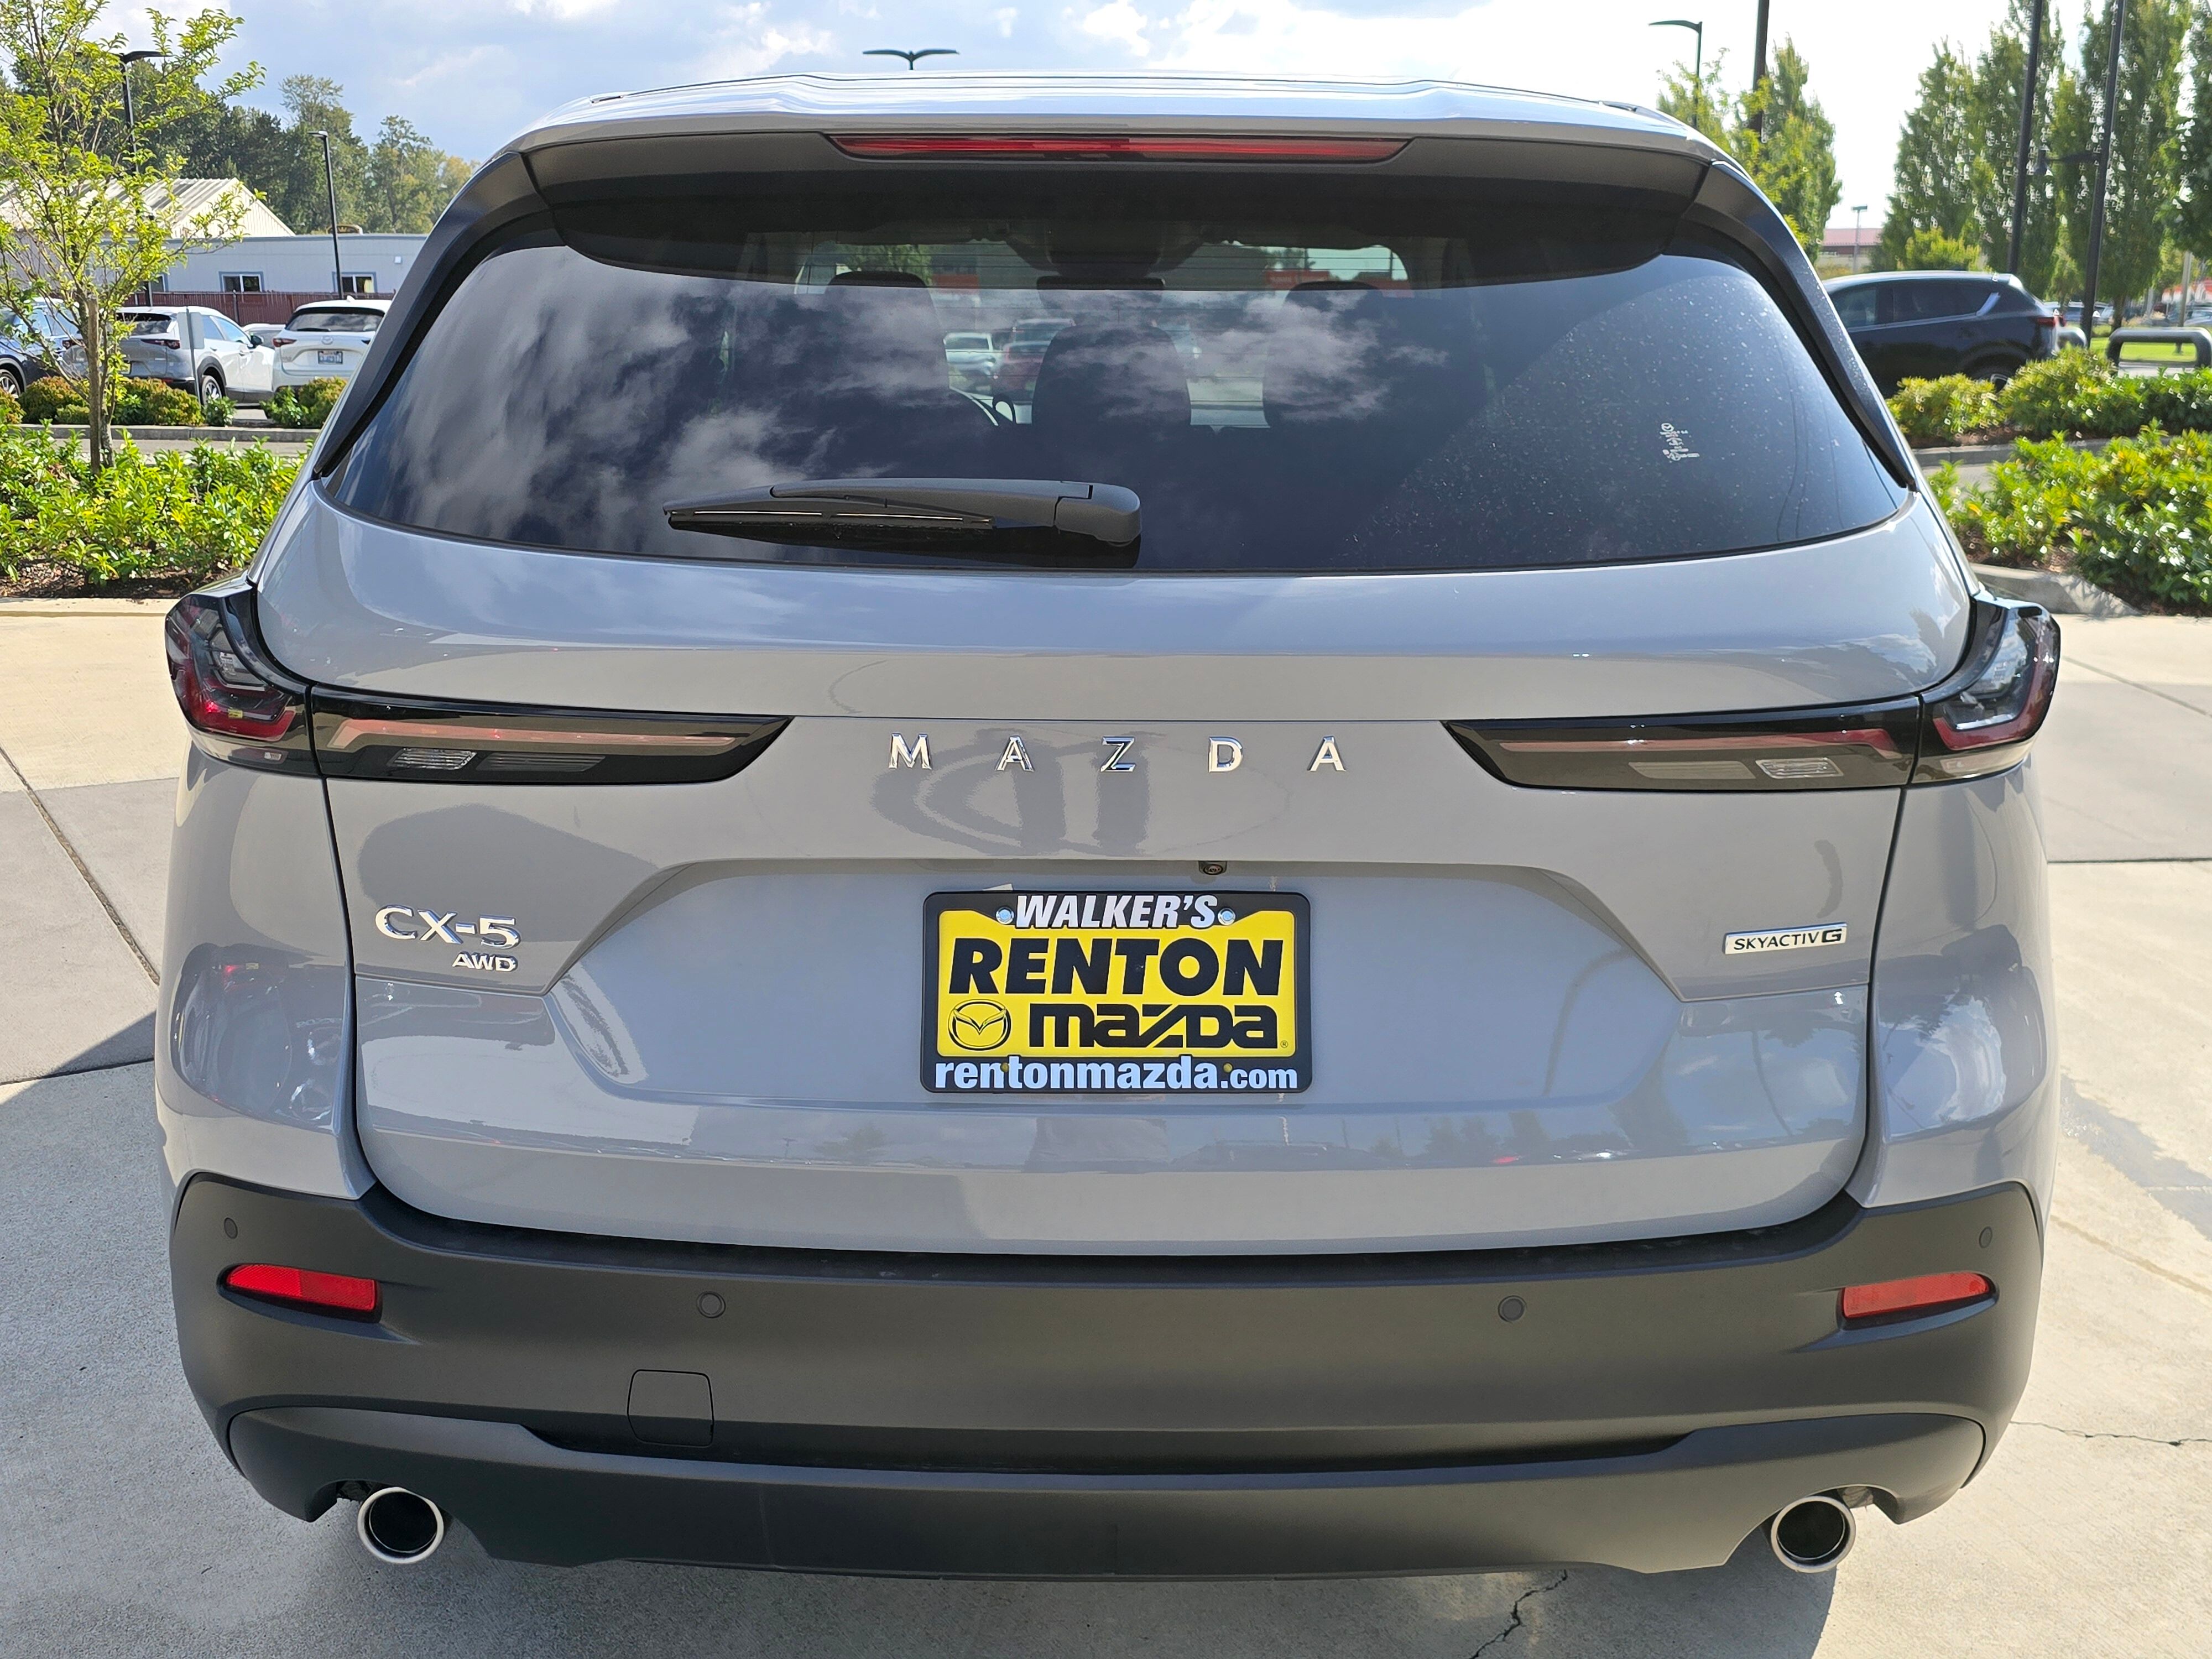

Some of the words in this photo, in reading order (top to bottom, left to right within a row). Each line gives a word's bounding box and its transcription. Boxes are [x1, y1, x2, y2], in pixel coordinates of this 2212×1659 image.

[888, 733, 1347, 773] MAZDA
[374, 904, 521, 950] CX-5
[1015, 894, 1219, 929] WALKER'S
[452, 951, 518, 972] AWD
[948, 938, 1284, 996] RENTON
[935, 1056, 1298, 1089] rentonmazda.com
